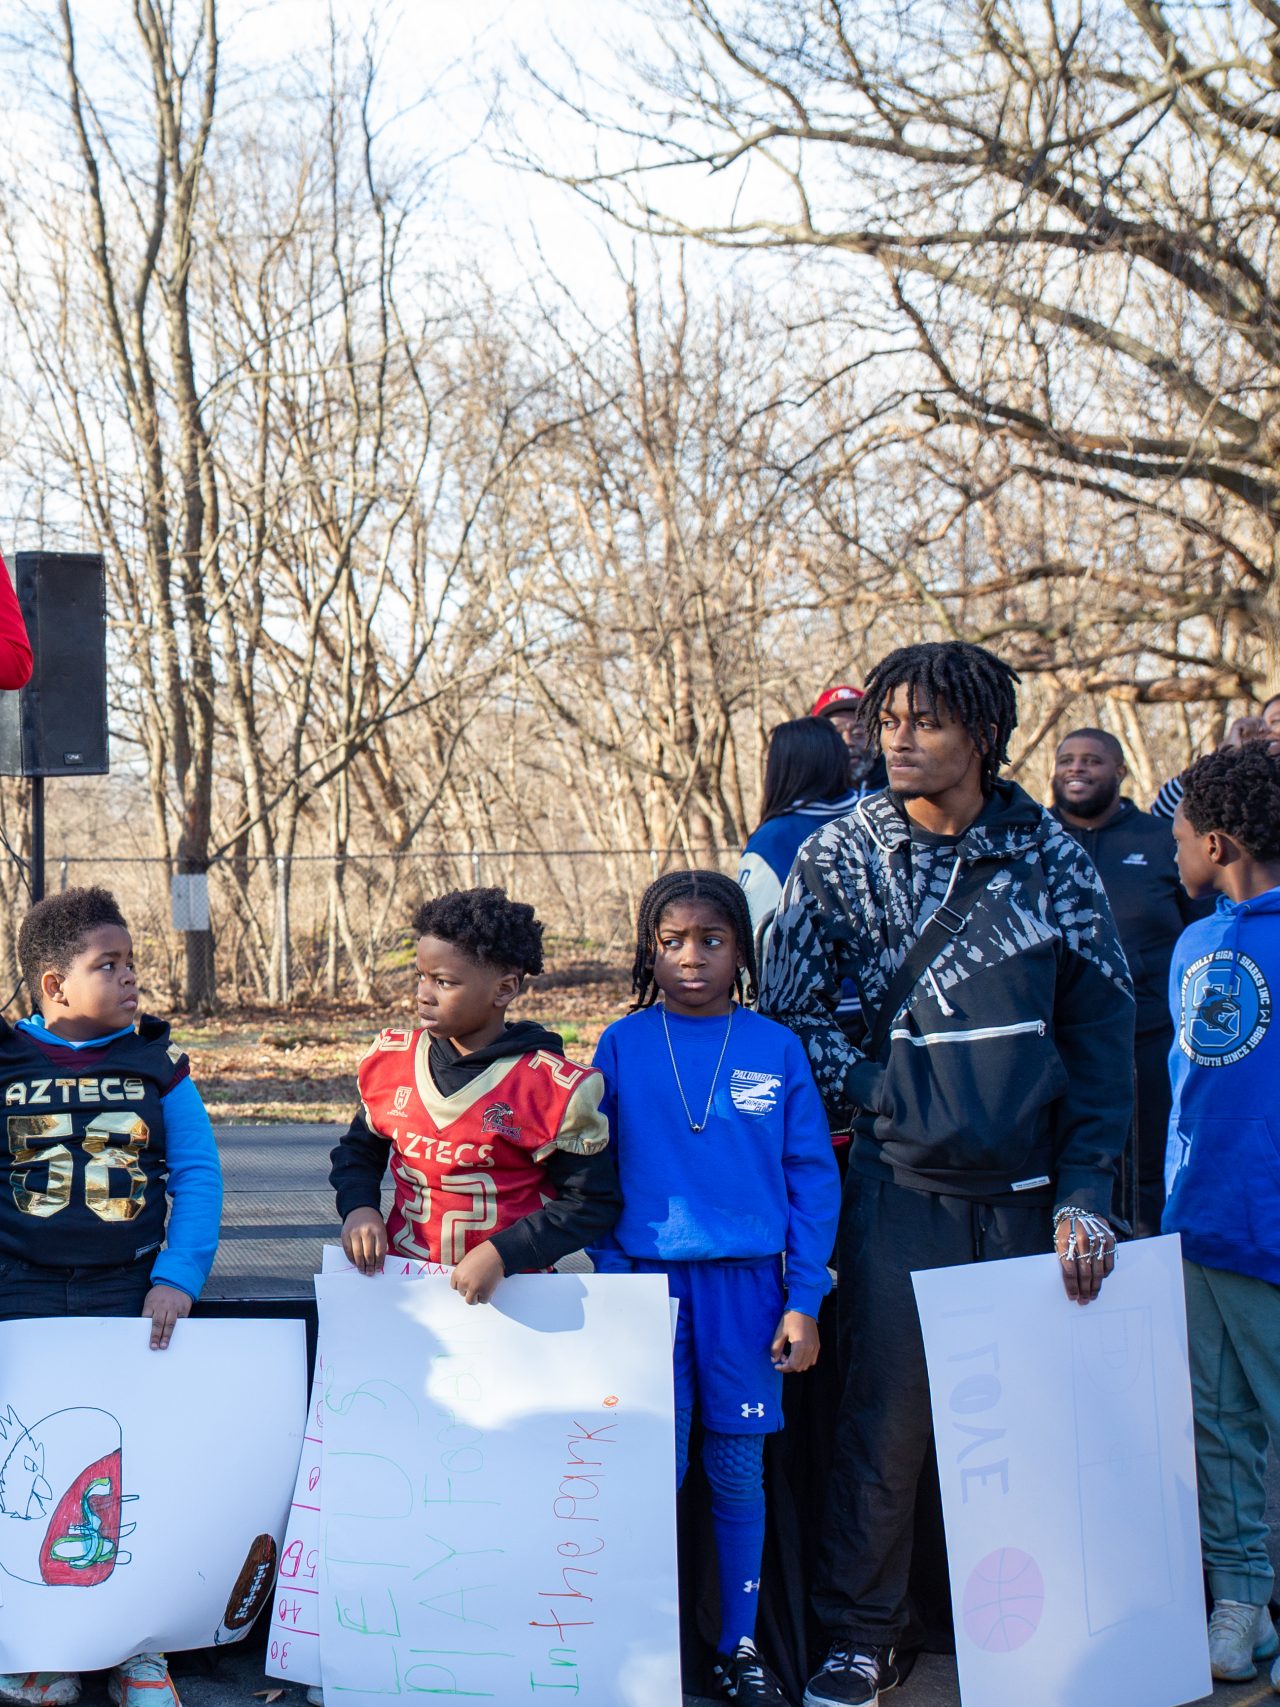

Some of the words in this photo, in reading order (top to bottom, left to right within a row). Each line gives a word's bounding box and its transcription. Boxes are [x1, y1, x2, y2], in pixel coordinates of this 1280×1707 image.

[1186, 952, 1215, 978] PHILLY
[1239, 955, 1265, 988] SHARKS
[1258, 987, 1270, 1005] INC
[1195, 1053, 1222, 1067] YOUTH
[1223, 1047, 1250, 1065] SINCE
[1246, 1026, 1266, 1049] 1992
[5, 1078, 146, 1106] AZTECS
[6, 1111, 150, 1222] 58
[324, 1364, 420, 1519] US
[278, 1599, 302, 1624] 40
[324, 1519, 411, 1695] LET
[528, 1537, 605, 1643] the
[270, 1641, 291, 1670] 30
[529, 1648, 580, 1697] In
